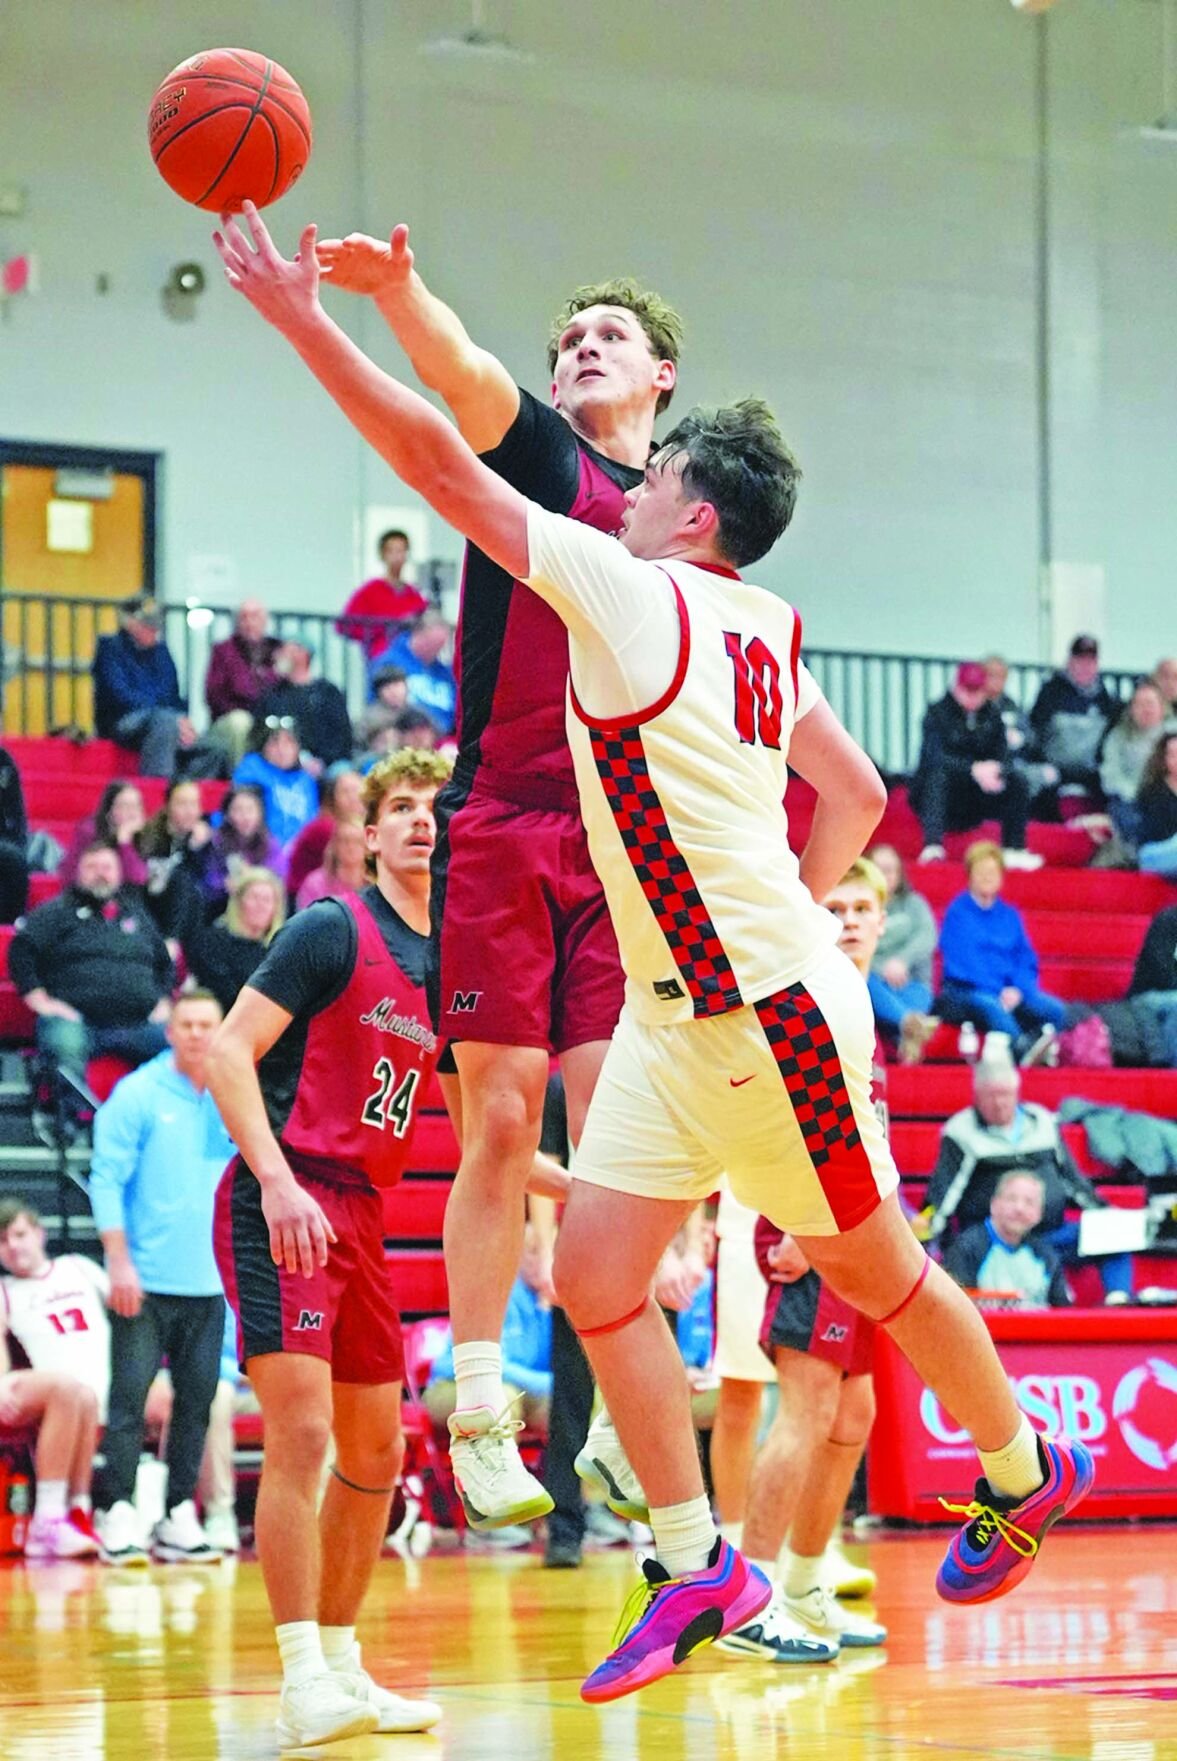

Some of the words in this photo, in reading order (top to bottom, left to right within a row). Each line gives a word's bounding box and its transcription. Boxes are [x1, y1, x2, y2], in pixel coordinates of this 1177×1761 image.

[722, 630, 782, 751] 10
[446, 991, 484, 1015] M
[360, 1056, 420, 1139] 24
[291, 1309, 325, 1331] M
[919, 1375, 1107, 1444] CSB
